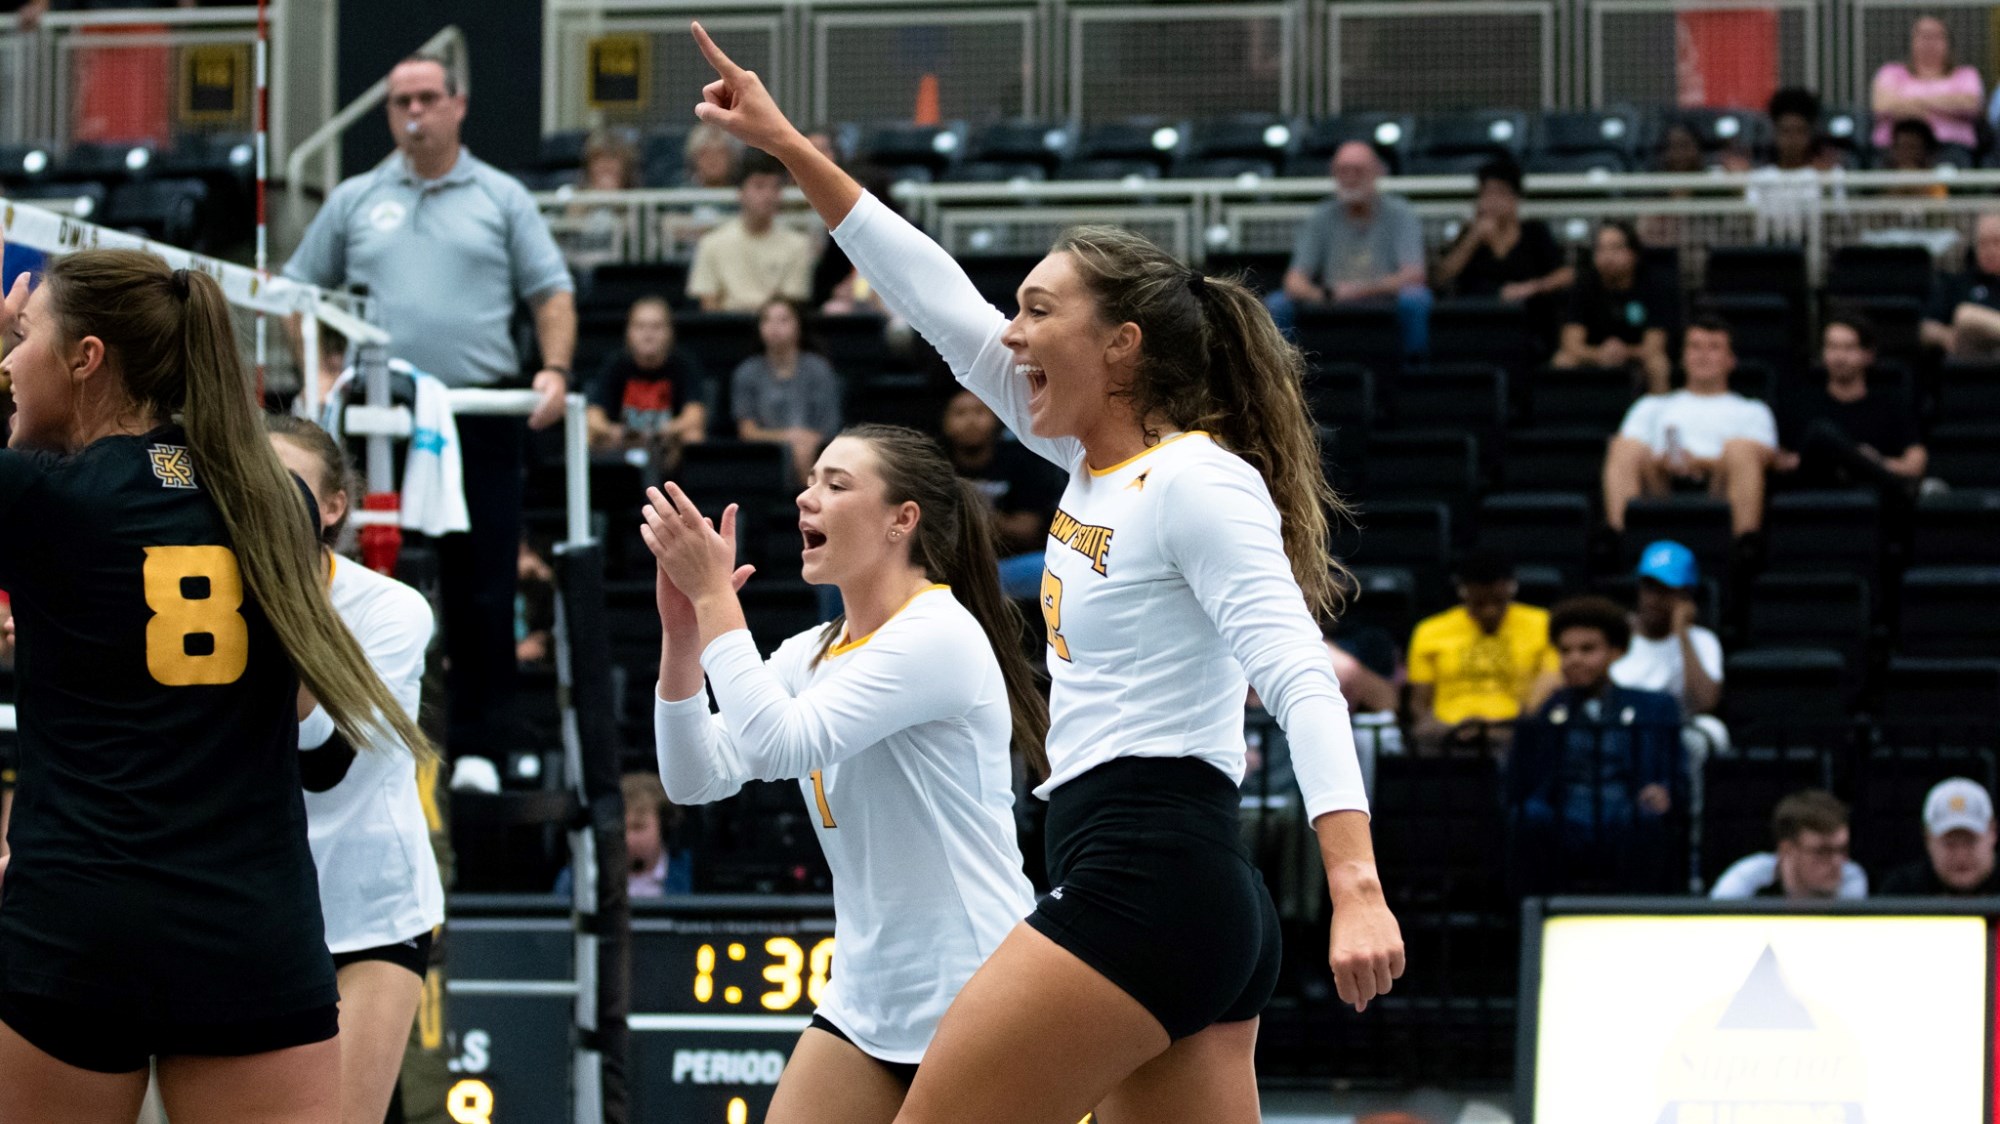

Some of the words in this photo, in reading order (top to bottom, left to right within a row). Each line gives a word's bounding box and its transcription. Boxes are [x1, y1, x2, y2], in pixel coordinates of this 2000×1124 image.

[1070, 523, 1114, 578] STATE
[142, 545, 249, 686] 8
[671, 1049, 787, 1085] PERIOD
